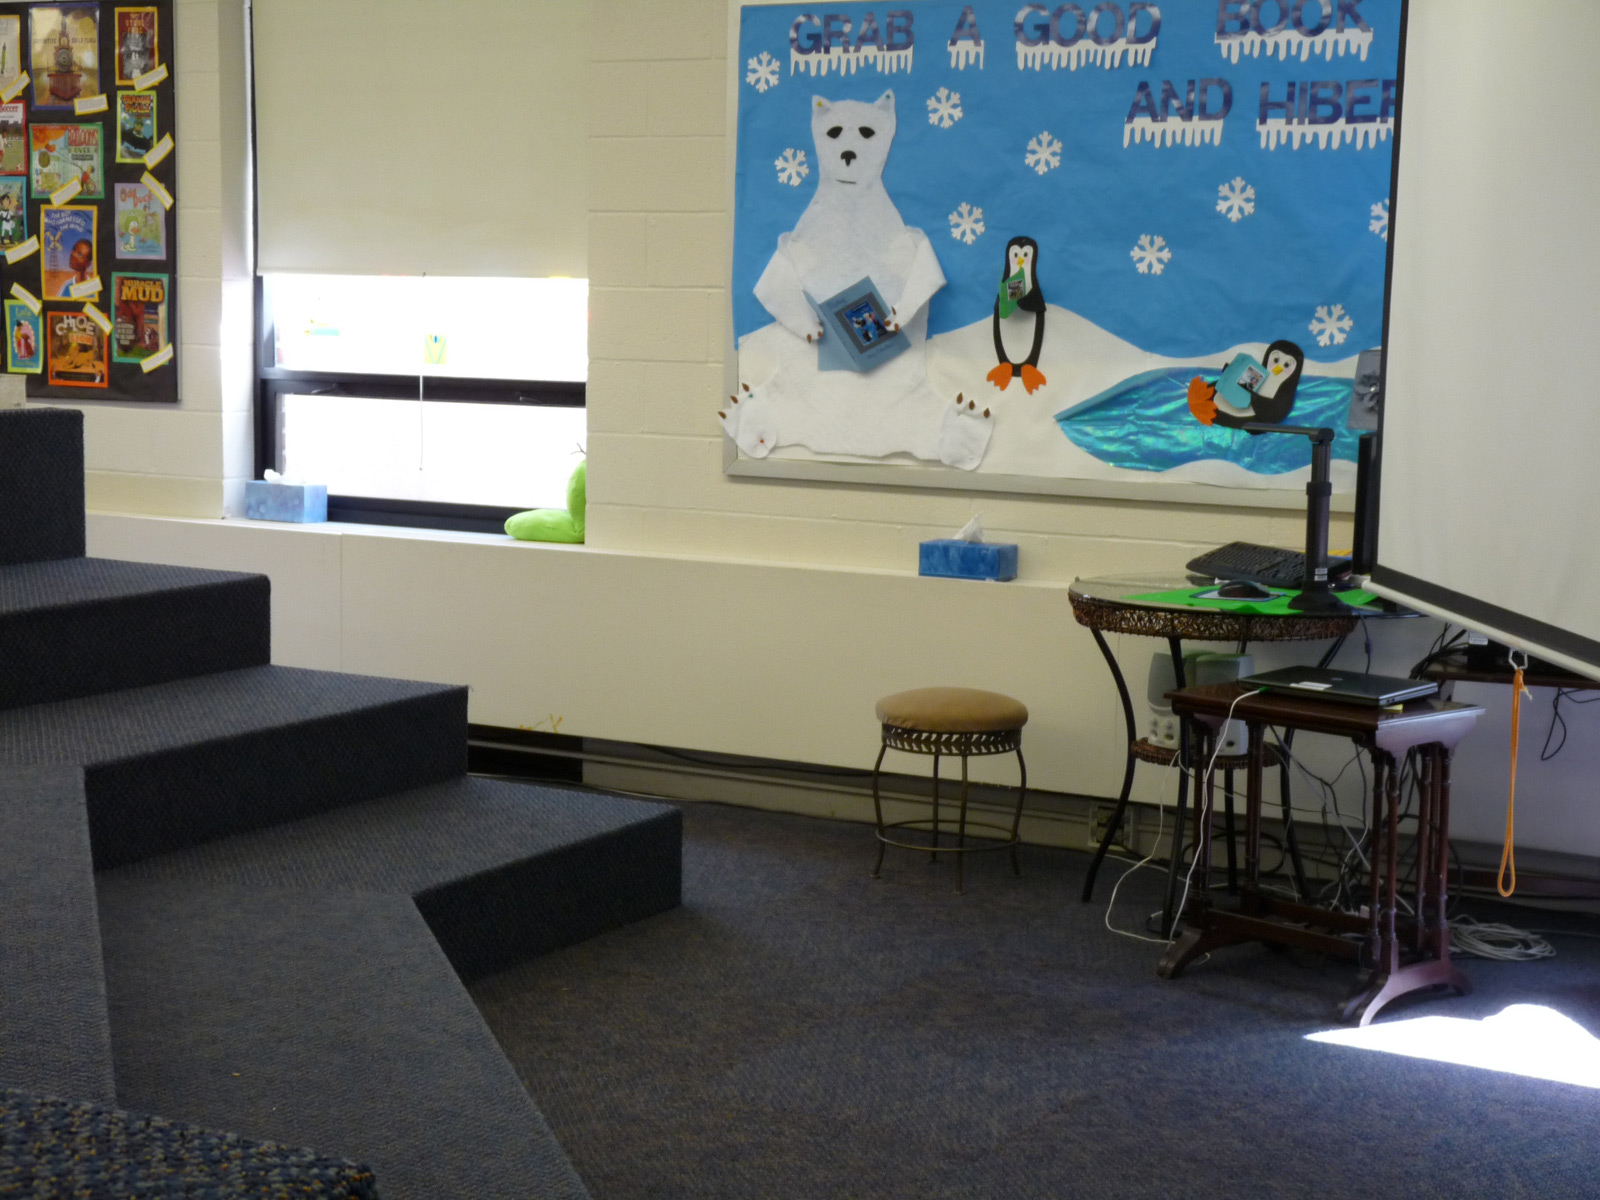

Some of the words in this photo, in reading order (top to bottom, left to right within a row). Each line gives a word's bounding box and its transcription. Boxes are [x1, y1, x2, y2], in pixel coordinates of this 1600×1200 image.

[789, 9, 914, 55] GRAB
[949, 5, 982, 47] A
[1014, 2, 1161, 47] GOOD
[1215, 0, 1373, 40] BOOK
[1125, 77, 1233, 125] AND
[121, 285, 164, 303] MUD
[55, 315, 96, 336] CHLOE
